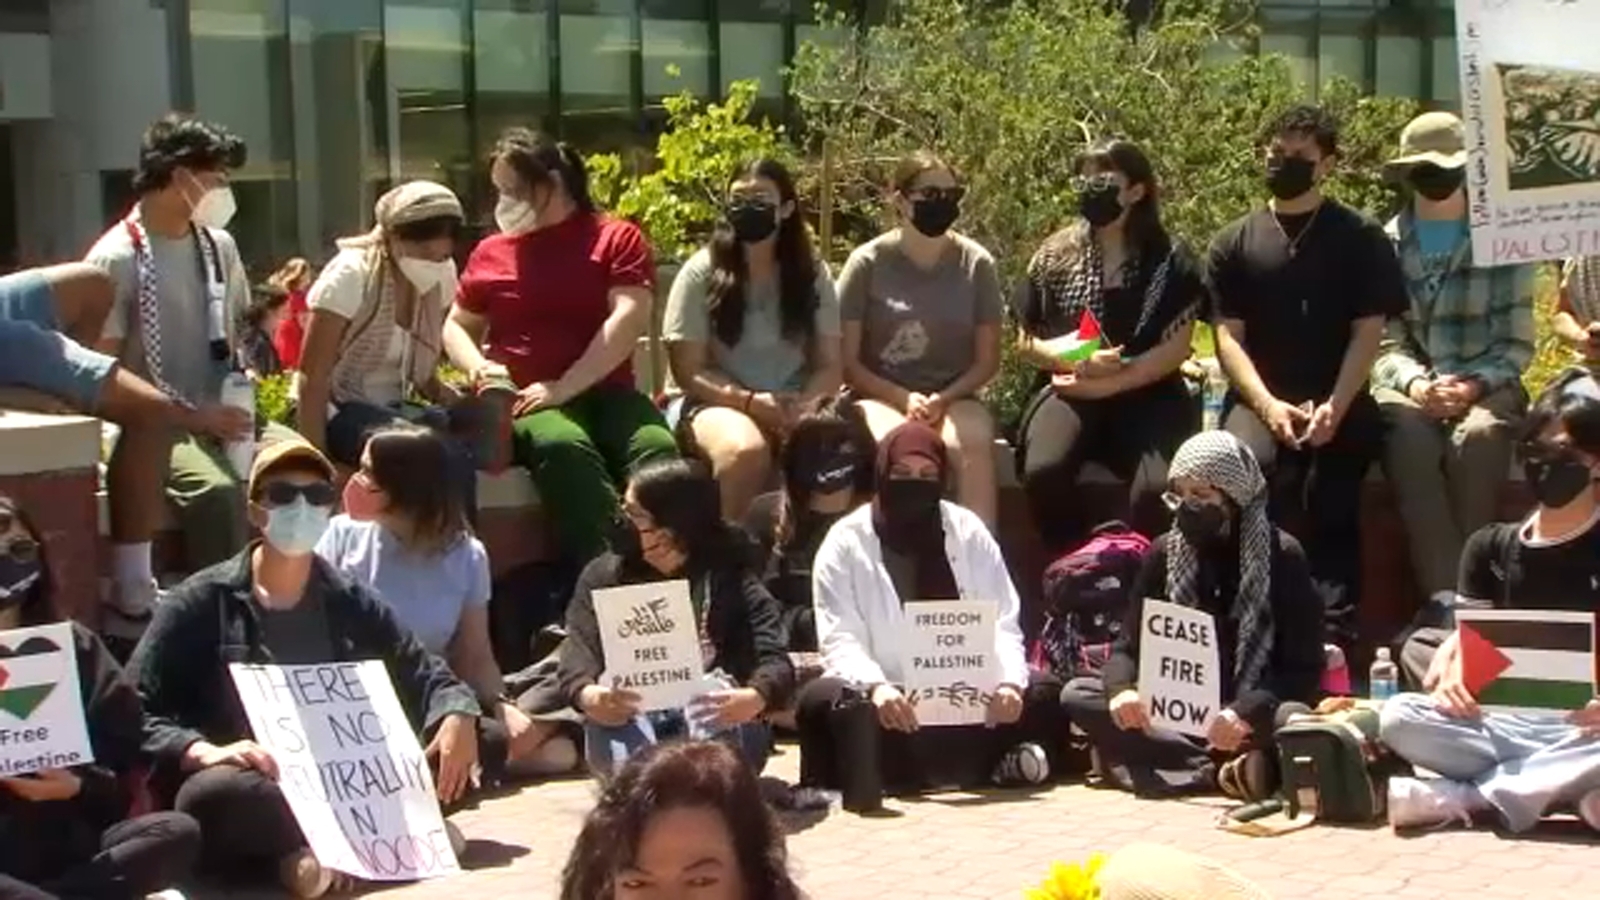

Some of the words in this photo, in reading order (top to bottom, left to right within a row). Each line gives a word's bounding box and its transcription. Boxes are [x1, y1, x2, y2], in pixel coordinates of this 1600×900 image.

[915, 612, 982, 627] FREEDOM
[1147, 614, 1211, 647] CEASE
[936, 634, 966, 647] FOR
[634, 647, 669, 662] FREE
[913, 655, 986, 670] PALESTINE
[612, 667, 692, 690] PALESTINE
[1160, 656, 1206, 686] FIRE
[240, 663, 371, 706] THERE
[1151, 694, 1211, 726] NOW
[0, 726, 49, 745] Free
[260, 715, 305, 753] IS
[327, 711, 391, 749] NO
[0, 751, 81, 772] lestine
[280, 752, 427, 803] EUTRALITY
